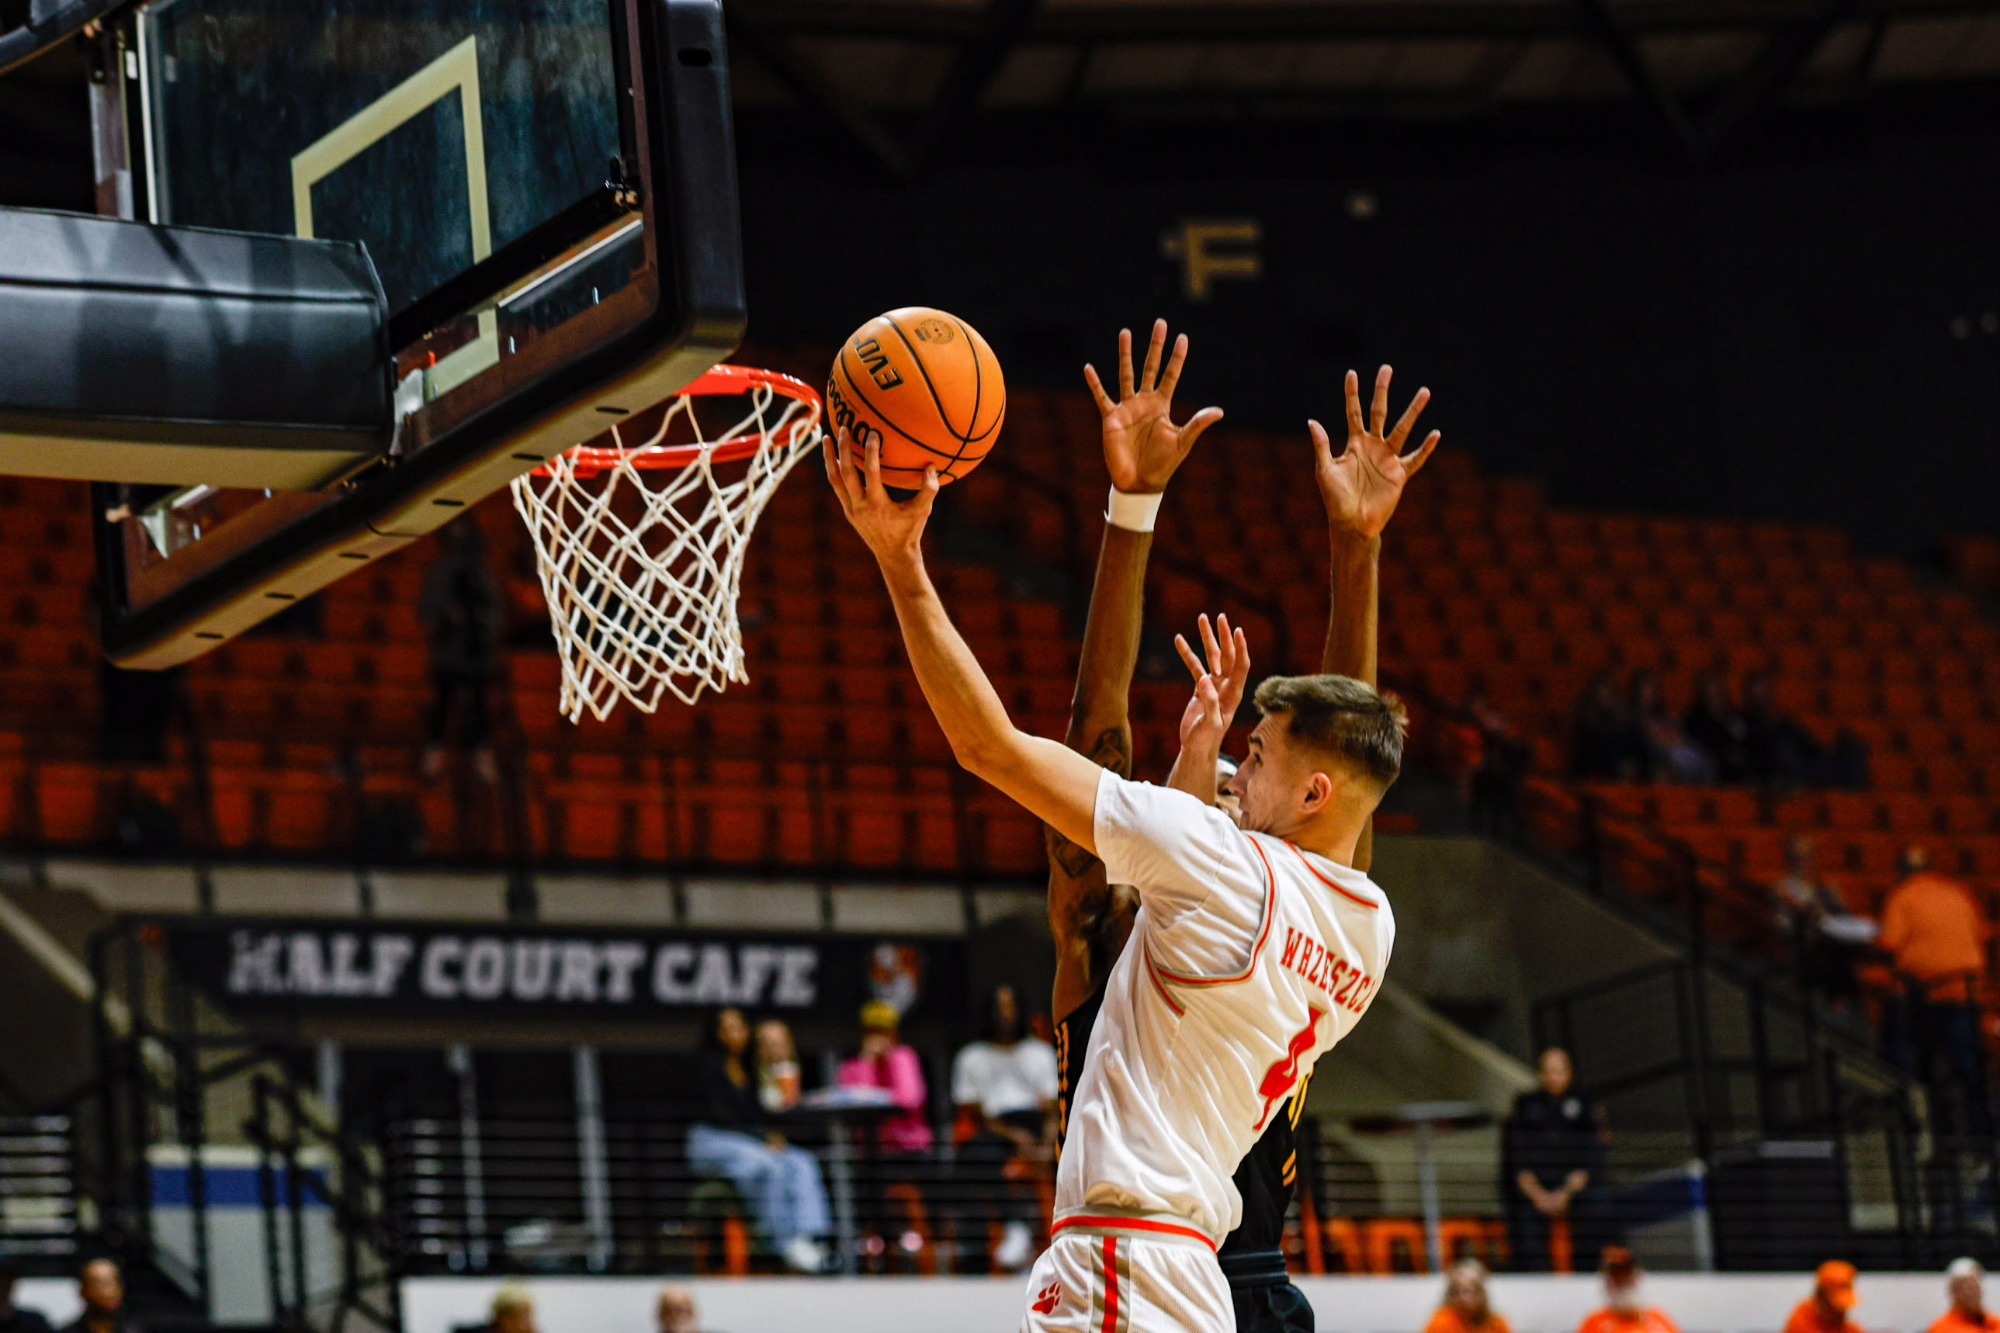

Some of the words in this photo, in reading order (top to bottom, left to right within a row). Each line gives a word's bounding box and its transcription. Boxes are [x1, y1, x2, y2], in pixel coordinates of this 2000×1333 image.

[1184, 220, 1260, 297] F
[856, 337, 904, 391] EVO
[828, 370, 884, 458] Wilso
[228, 930, 414, 995] HALF
[420, 936, 648, 1002] COURT
[652, 944, 819, 1006] CAFE
